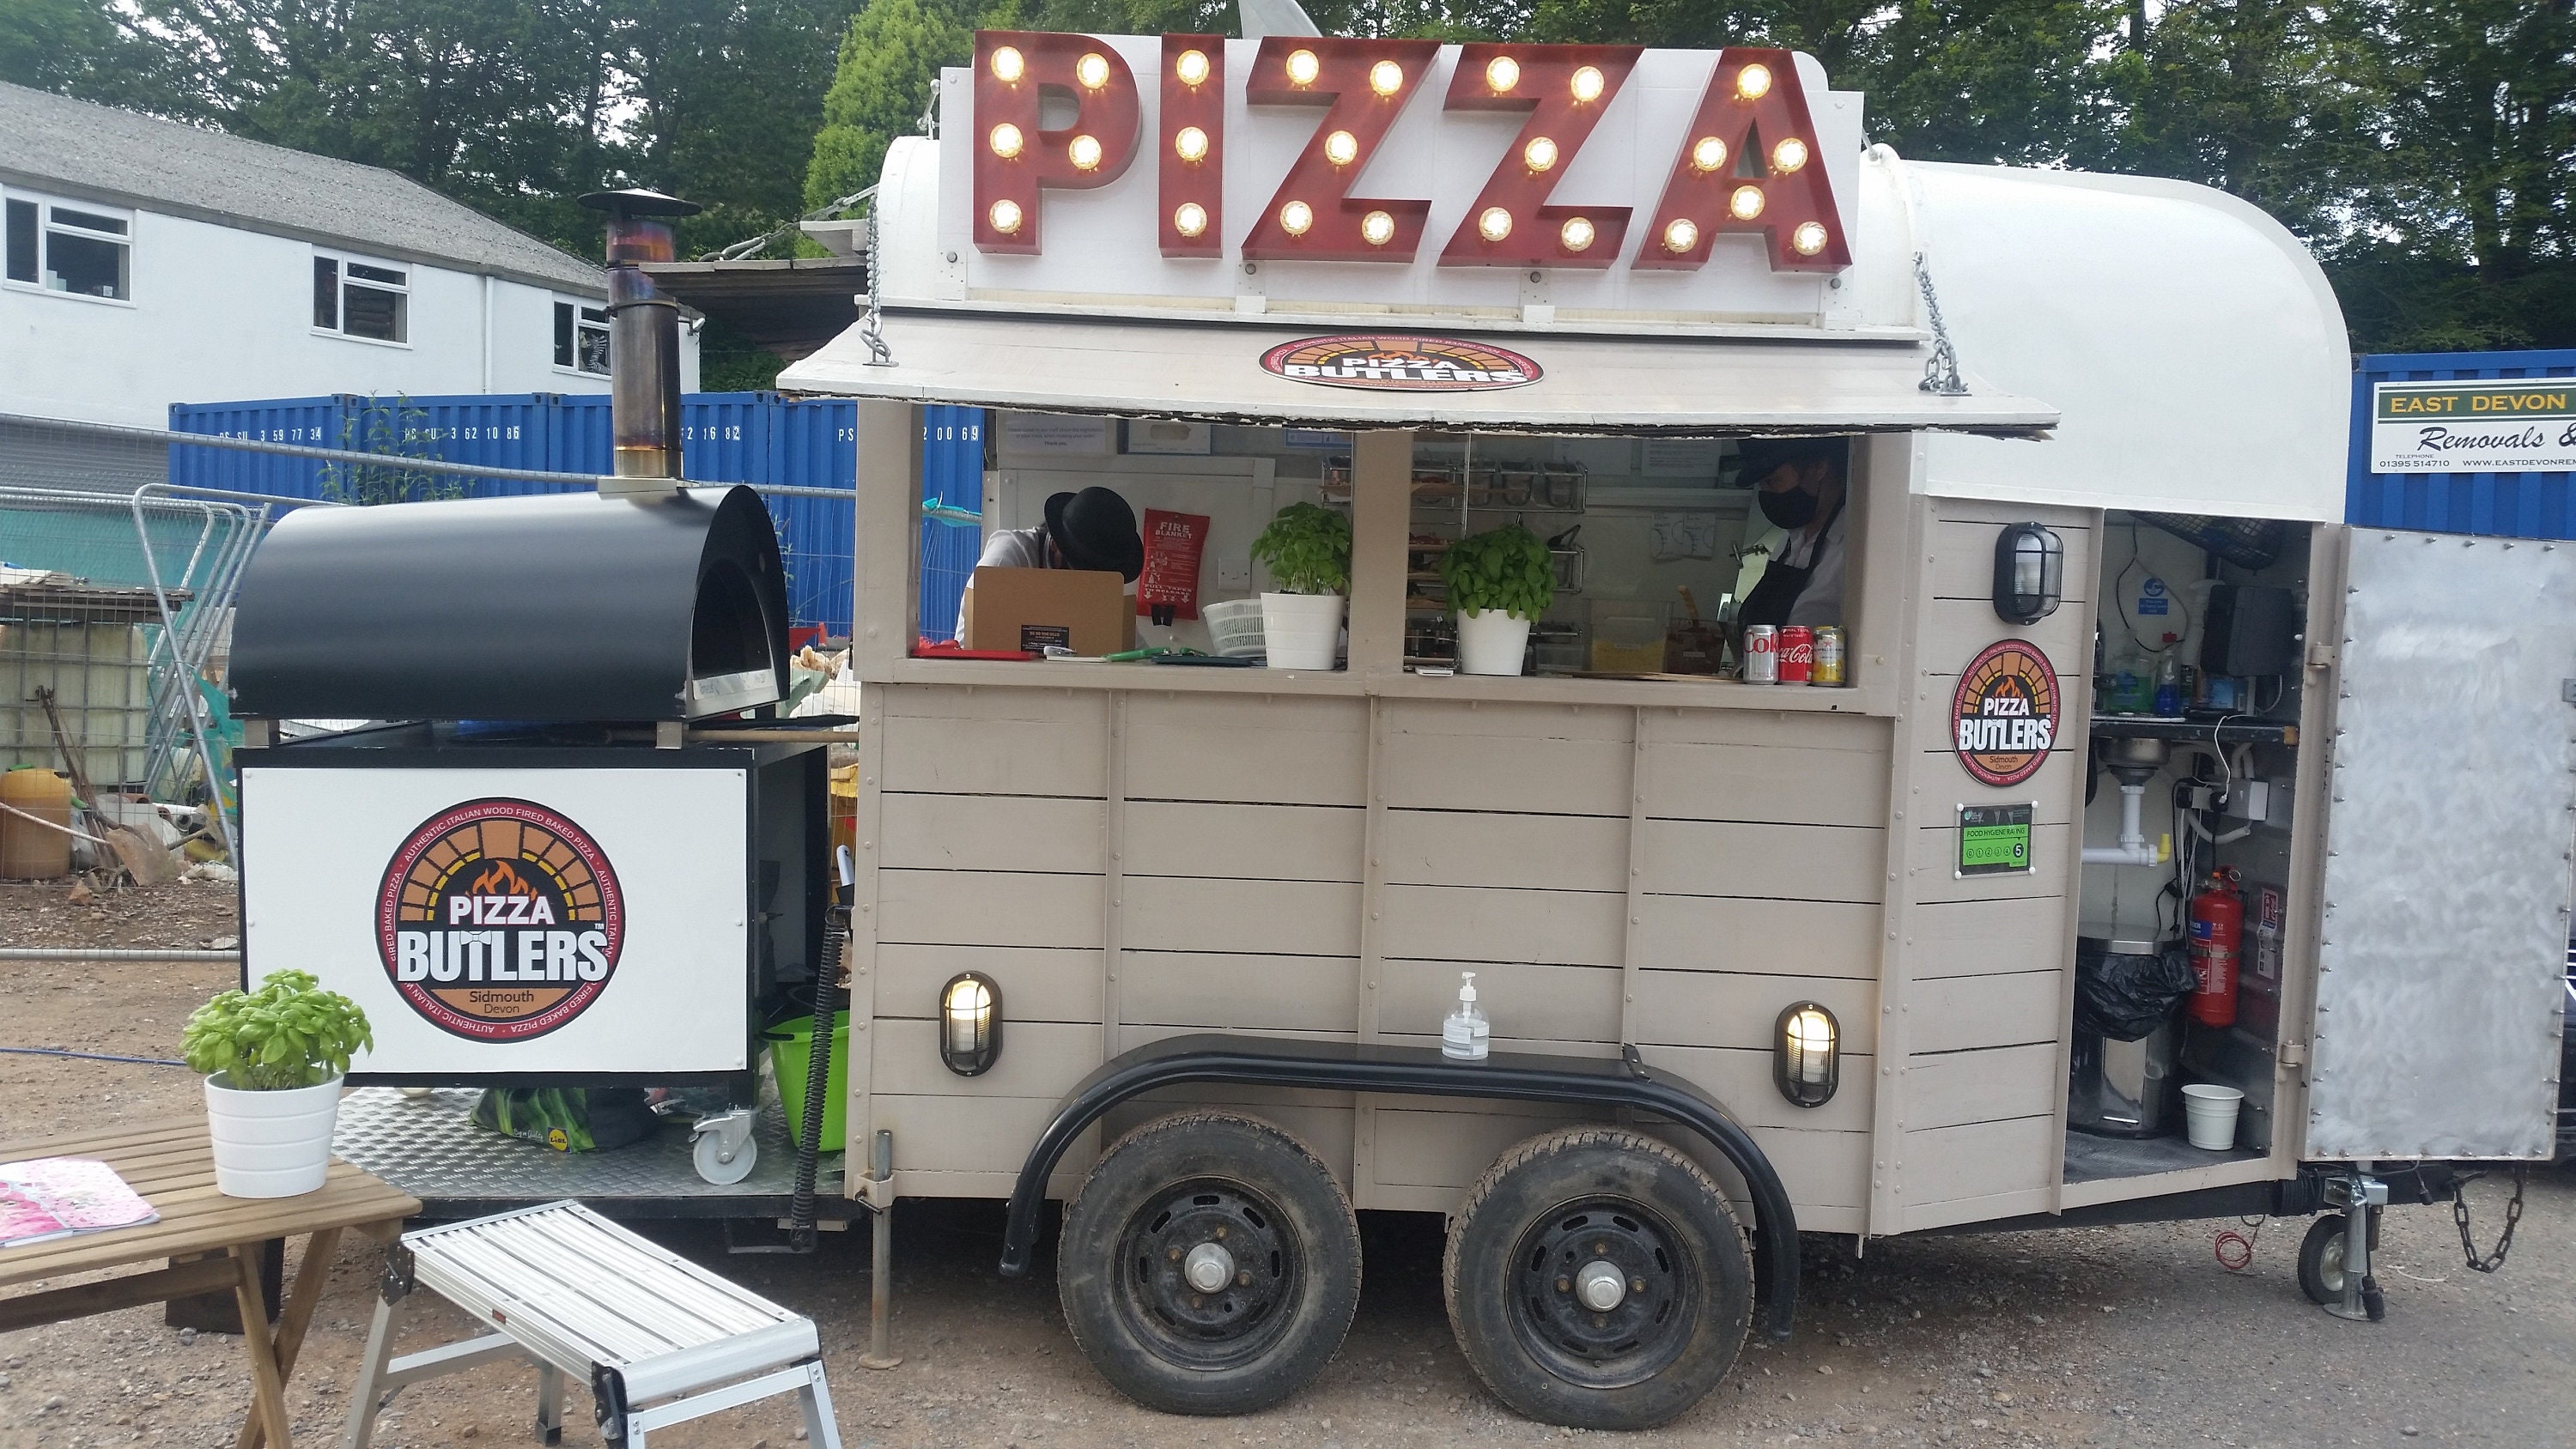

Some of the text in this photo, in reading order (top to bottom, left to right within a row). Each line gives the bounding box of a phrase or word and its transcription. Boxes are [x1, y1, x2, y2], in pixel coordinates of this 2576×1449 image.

[973, 29, 1852, 272] PIZZA
[1343, 358, 1461, 369] PIZZA
[1285, 365, 1528, 382] BUTLERS
[2391, 394, 2567, 413] EAST DEVON
[273, 429, 283, 442] 59
[292, 428, 302, 441] 77
[451, 427, 456, 440] 3
[465, 427, 477, 440] 62
[486, 427, 498, 440] 10
[507, 425, 519, 440] 86
[682, 426, 740, 440] 2 16 82
[838, 428, 854, 442] PS
[937, 427, 952, 440] 00
[962, 426, 979, 441] 69
[2417, 426, 2545, 452] Removals
[2413, 459, 2450, 468] 514710
[1155, 530, 1193, 539] BLANKET
[1160, 521, 1190, 532] FIRE
[1968, 654, 1989, 677] AUTHENTIC
[1989, 645, 2005, 656] ITALIAN
[2032, 651, 2044, 664] BAKED
[2043, 662, 2051, 676] PIZZA
[1958, 683, 1966, 699] PIZZA
[1984, 698, 2030, 716] PIZZA
[1959, 718, 2051, 750] BUTLERS
[404, 822, 446, 862] AUTHENTIC
[447, 809, 481, 826] ITALIAN
[516, 808, 544, 822] FIRED
[545, 818, 575, 839] BAKED
[574, 837, 594, 860] PIZZA
[2015, 845, 2021, 856] 5
[387, 872, 402, 898] PIZZA
[597, 870, 617, 921] AUTHENTIC
[385, 900, 393, 931] BAKED
[450, 895, 555, 925] PIZZA
[397, 931, 608, 981] BUTLERS
[470, 990, 534, 1003] Sidmouth
[412, 988, 495, 1034] AUTHENTIC ITALIAN
[484, 1004, 519, 1013] Devon
[511, 985, 592, 1033] FIRED BAKED PIZZA
